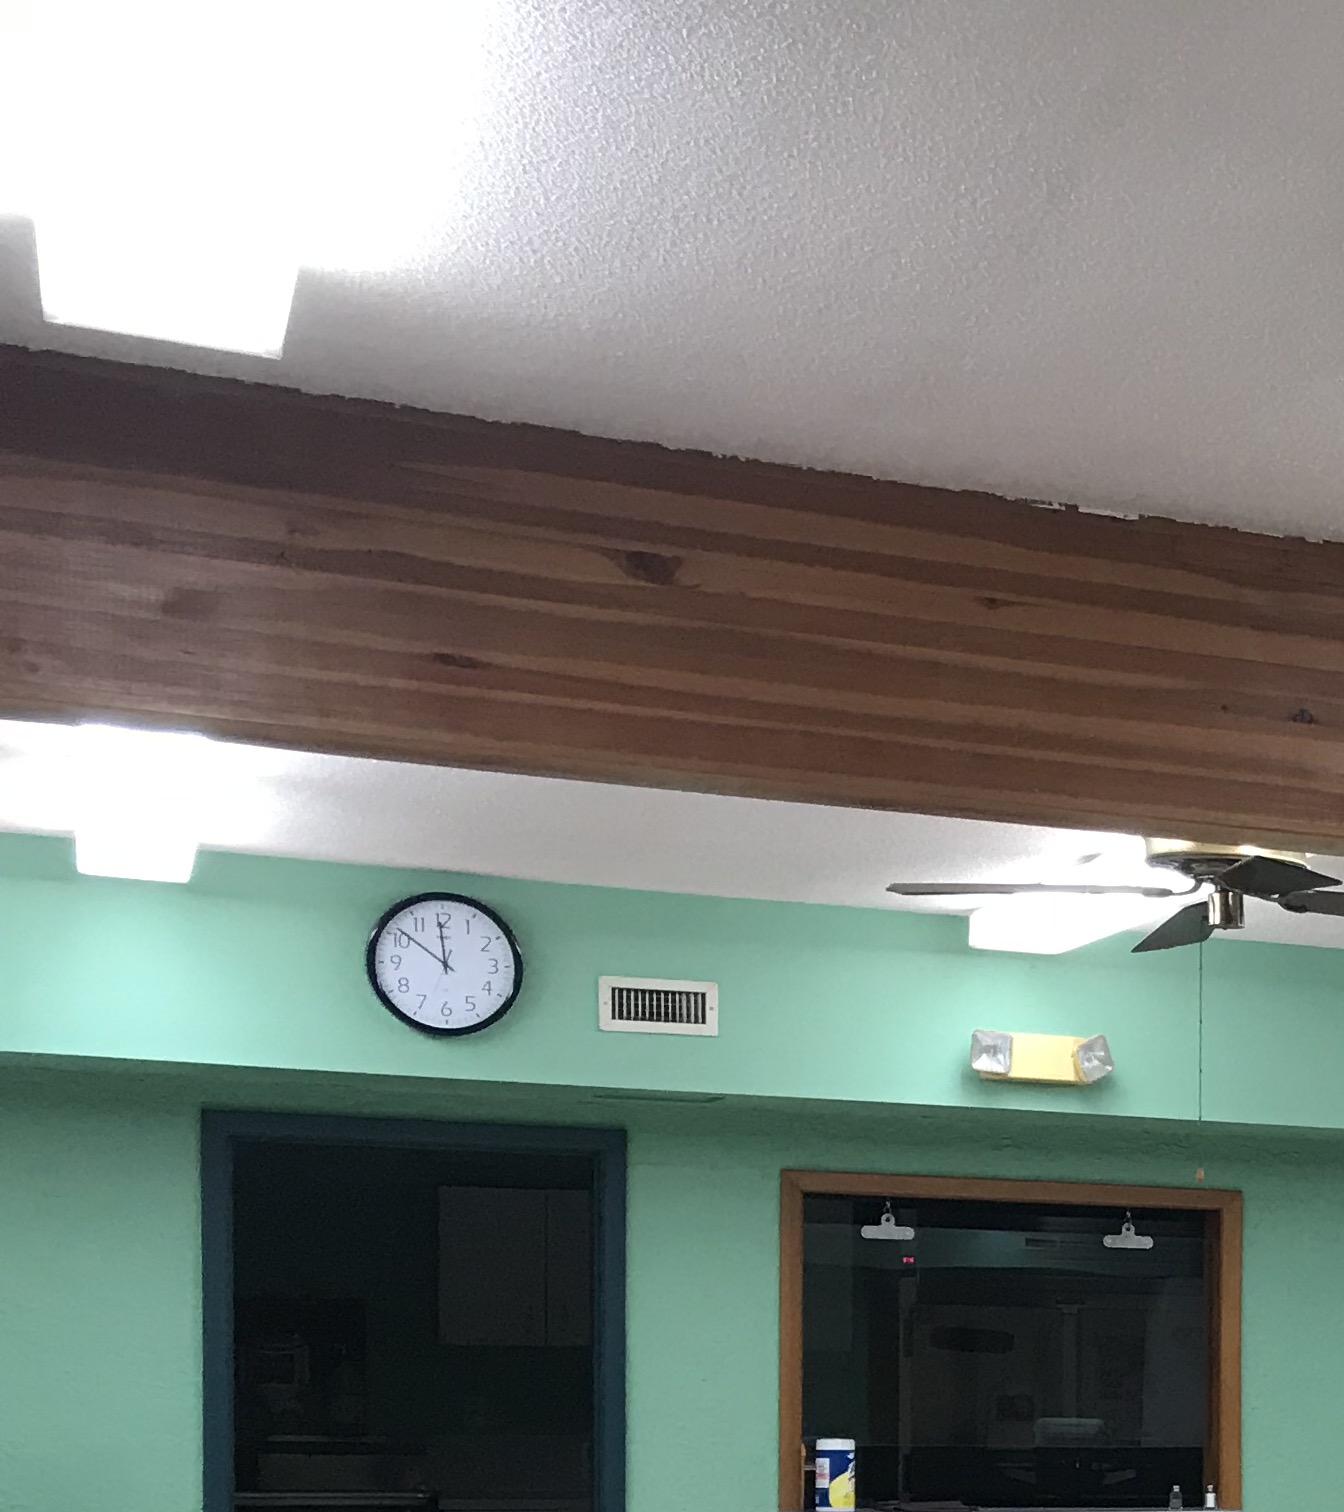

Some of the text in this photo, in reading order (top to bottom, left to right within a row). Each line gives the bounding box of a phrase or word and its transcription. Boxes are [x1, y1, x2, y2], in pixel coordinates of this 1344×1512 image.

[413, 916, 425, 932] 11
[465, 919, 470, 935] 1
[392, 932, 411, 949] 10
[480, 936, 492, 952] 2
[390, 954, 402, 970] 9
[488, 958, 499, 974] 3
[397, 977, 410, 993] 8
[481, 980, 493, 996] 4
[416, 994, 427, 1010] 7
[440, 1001, 453, 1017] 6
[465, 995, 476, 1012] 5
